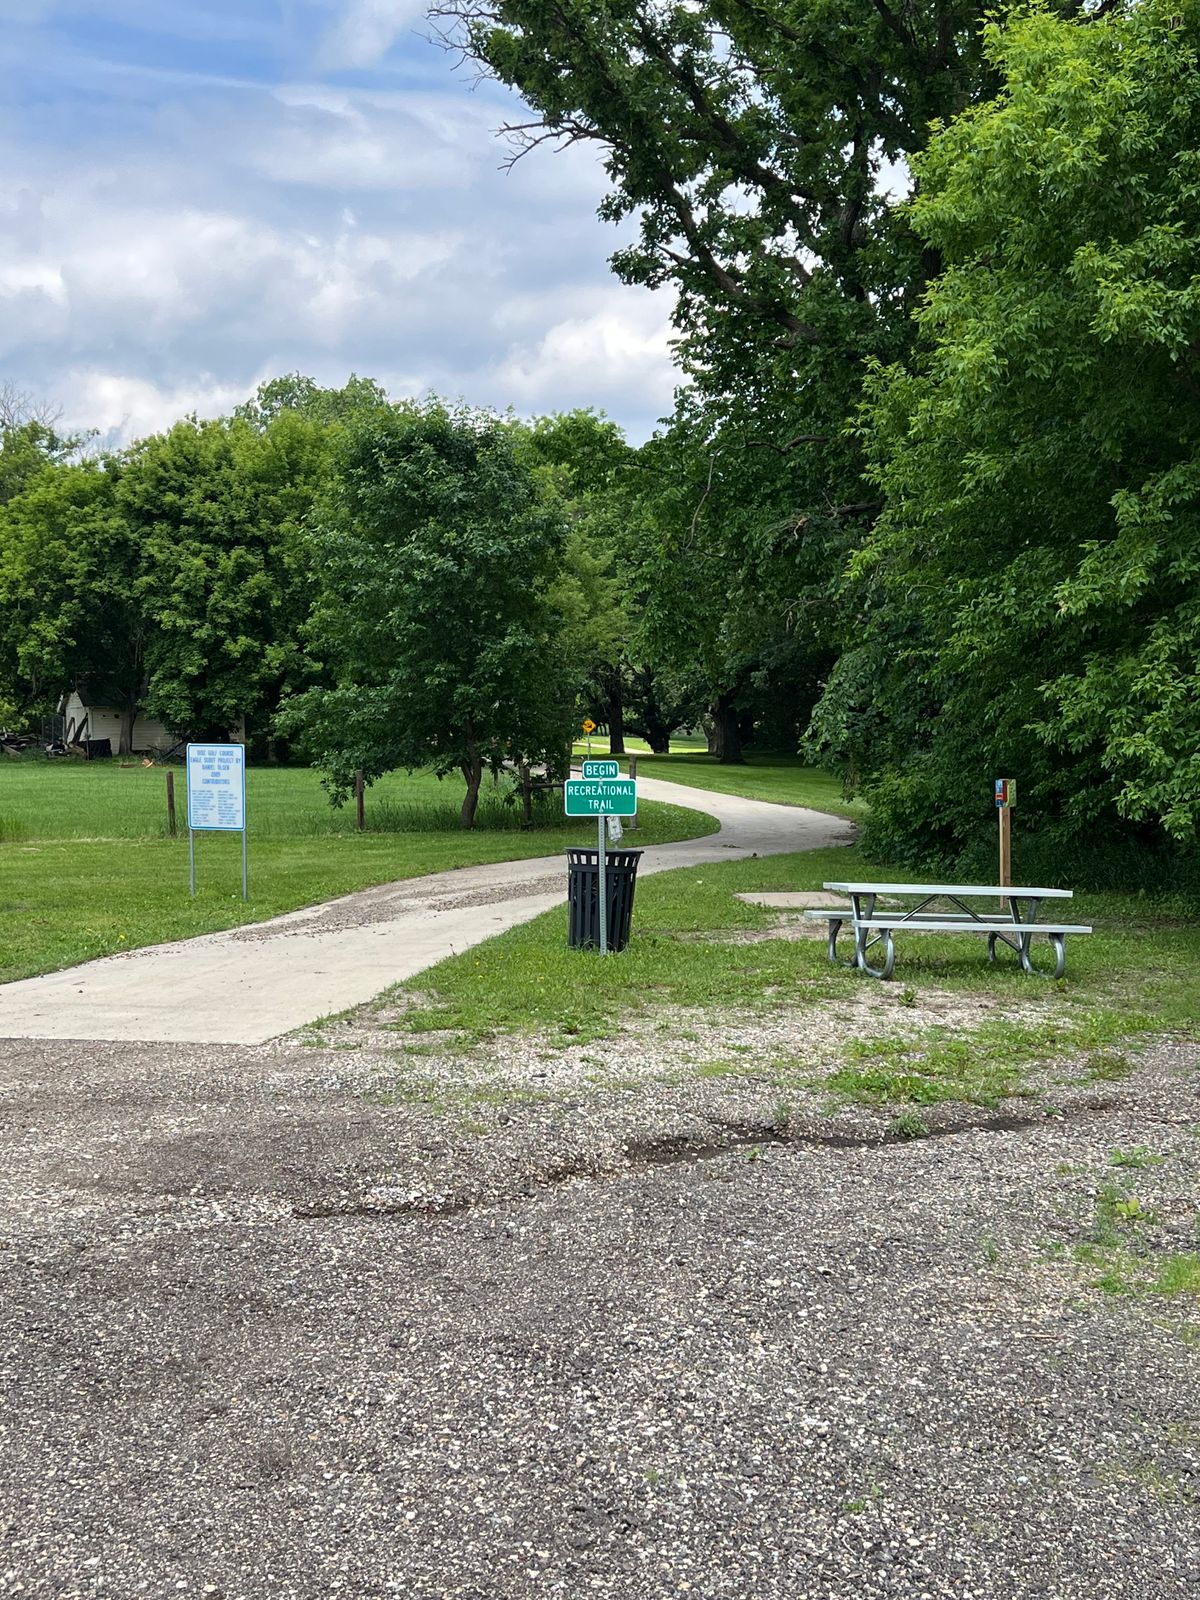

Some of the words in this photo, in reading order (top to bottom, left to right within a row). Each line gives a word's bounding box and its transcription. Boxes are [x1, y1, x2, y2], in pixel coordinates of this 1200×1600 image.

[586, 765, 615, 775] BEGIN
[568, 786, 633, 795] RECREATIONAL
[588, 800, 614, 809] TRAIL
